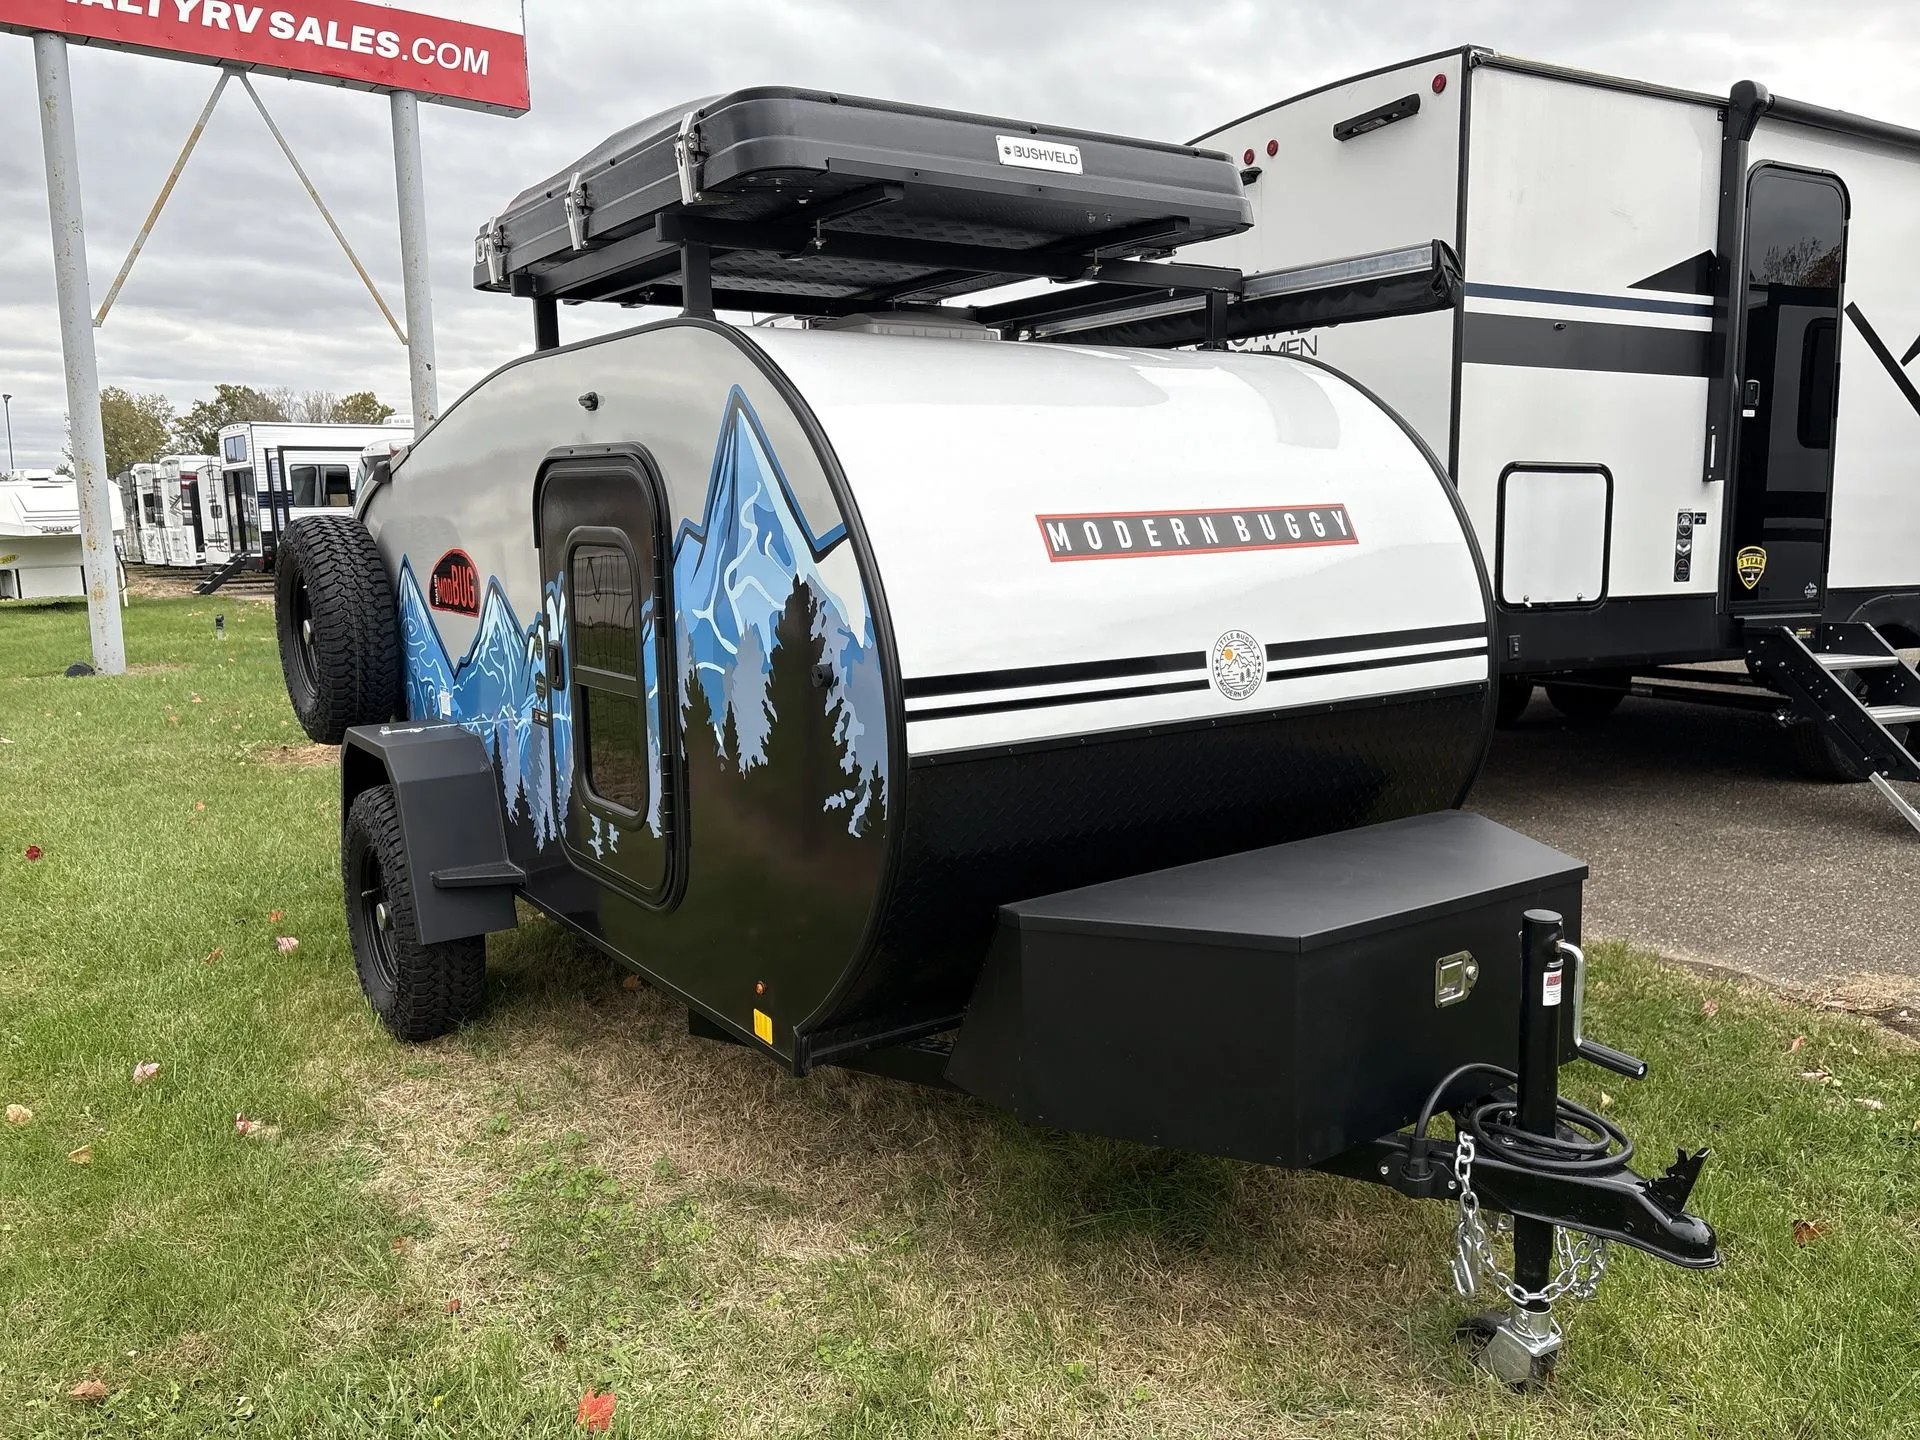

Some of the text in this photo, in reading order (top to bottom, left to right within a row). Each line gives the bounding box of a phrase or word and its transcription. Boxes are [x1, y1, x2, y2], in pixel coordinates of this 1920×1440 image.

[66, 0, 490, 76] LTYRV SALES.COM
[1013, 145, 1078, 165] BUSHVELD
[1045, 510, 1349, 552] MODERN BUGGY
[1746, 557, 1764, 567] YEAR
[1216, 632, 1257, 653] LITTLE BUGGY
[1218, 675, 1260, 698] MODERN BUGGY
